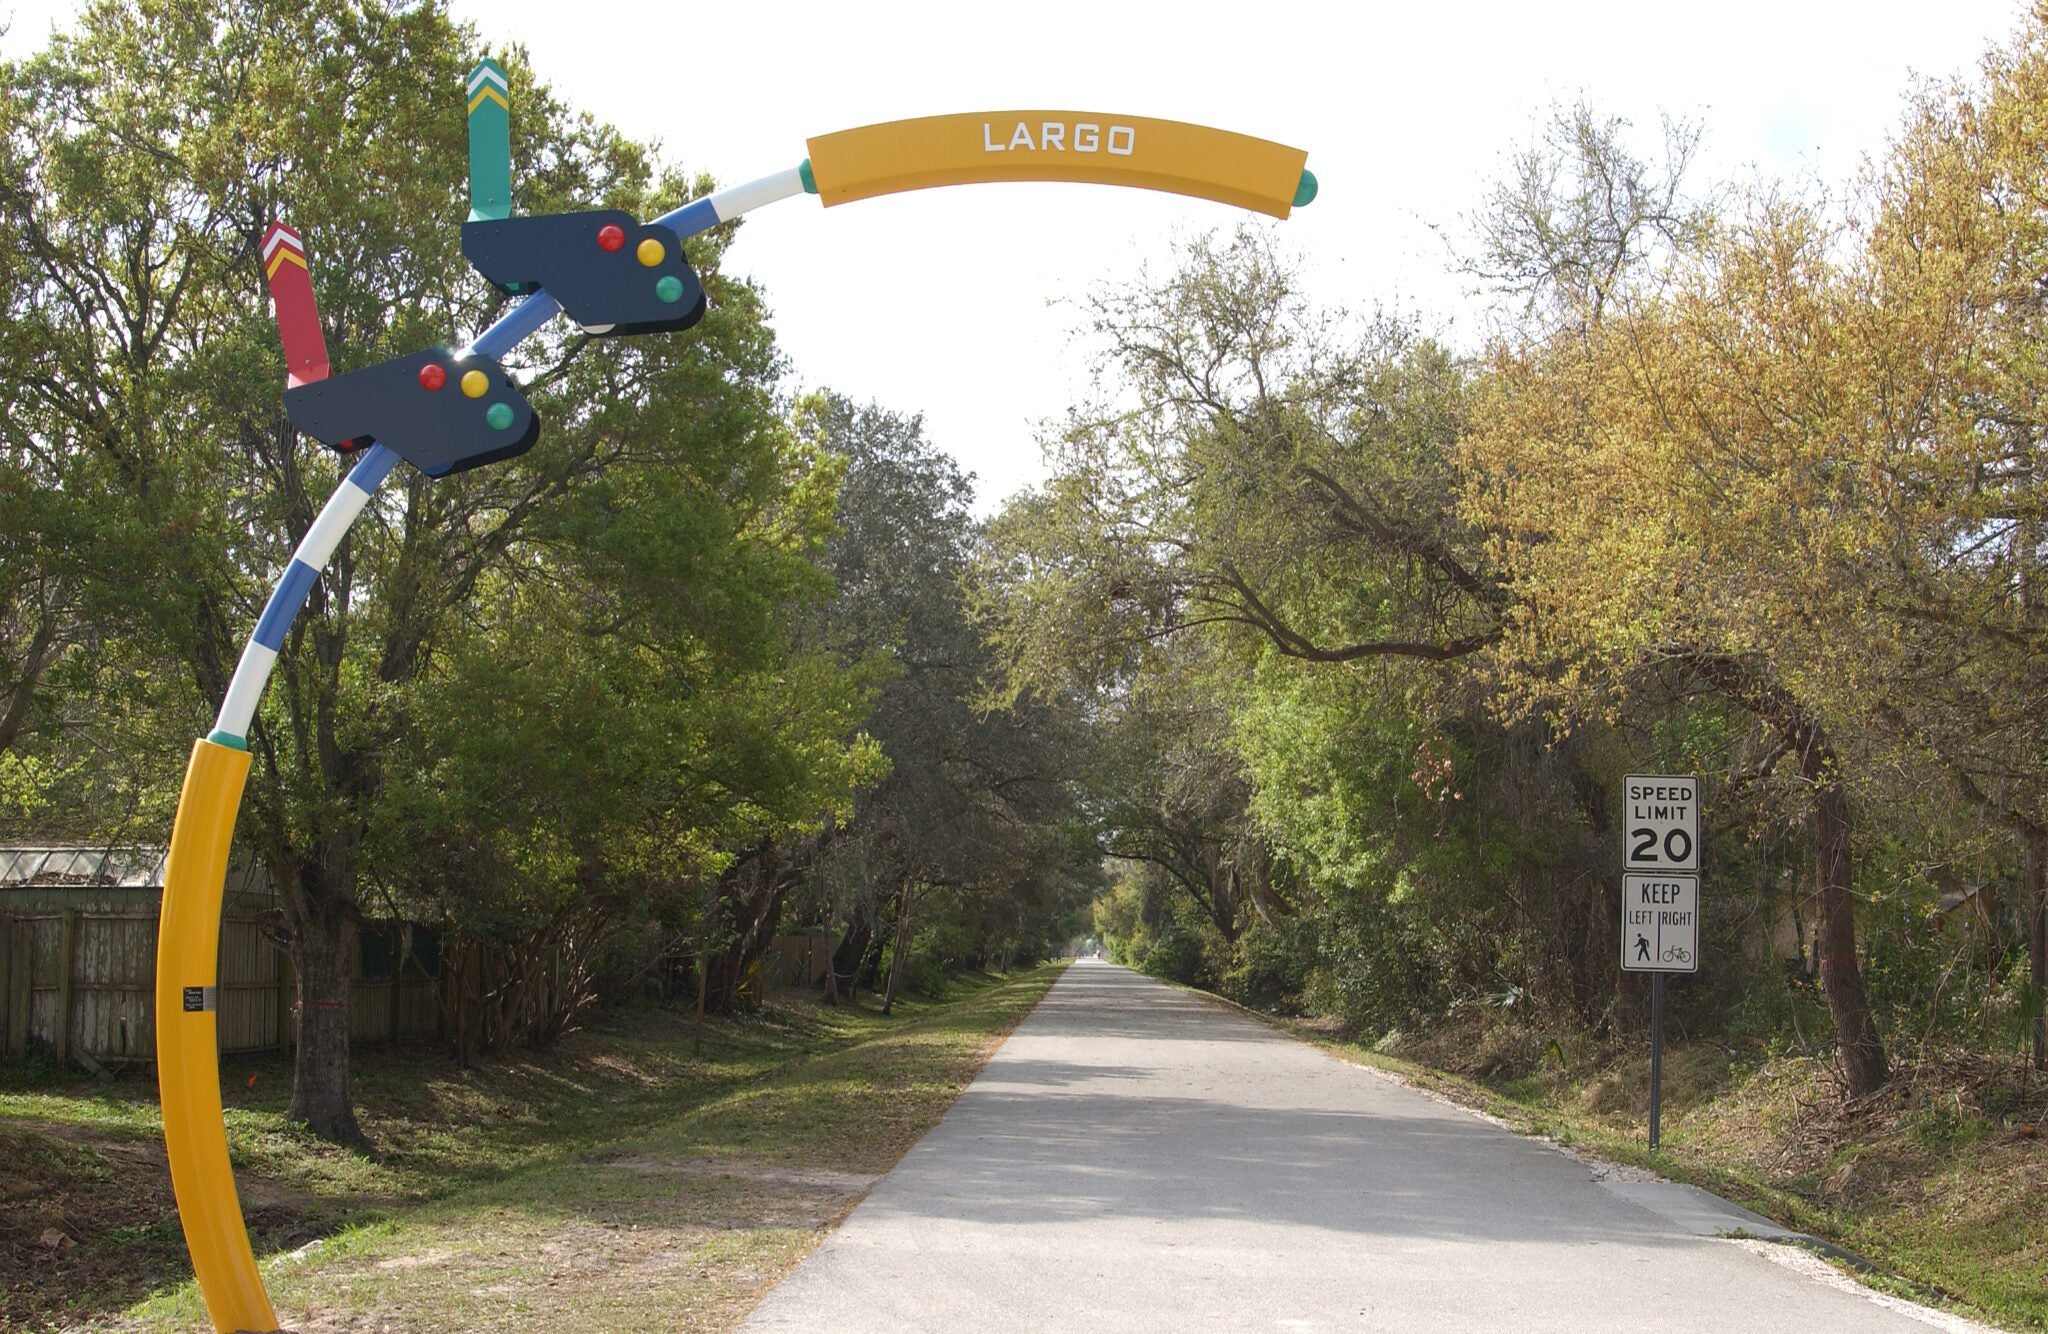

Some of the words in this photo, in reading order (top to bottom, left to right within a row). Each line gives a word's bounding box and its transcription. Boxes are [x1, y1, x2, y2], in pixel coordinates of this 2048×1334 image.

[983, 121, 1135, 156] LARGO
[1630, 786, 1693, 801] SPEED
[1634, 805, 1688, 821] LIMIT
[1630, 827, 1693, 863] 20
[1641, 883, 1681, 905] KEEP
[1629, 910, 1654, 926] LEFT
[1661, 911, 1693, 926] RIGHT
